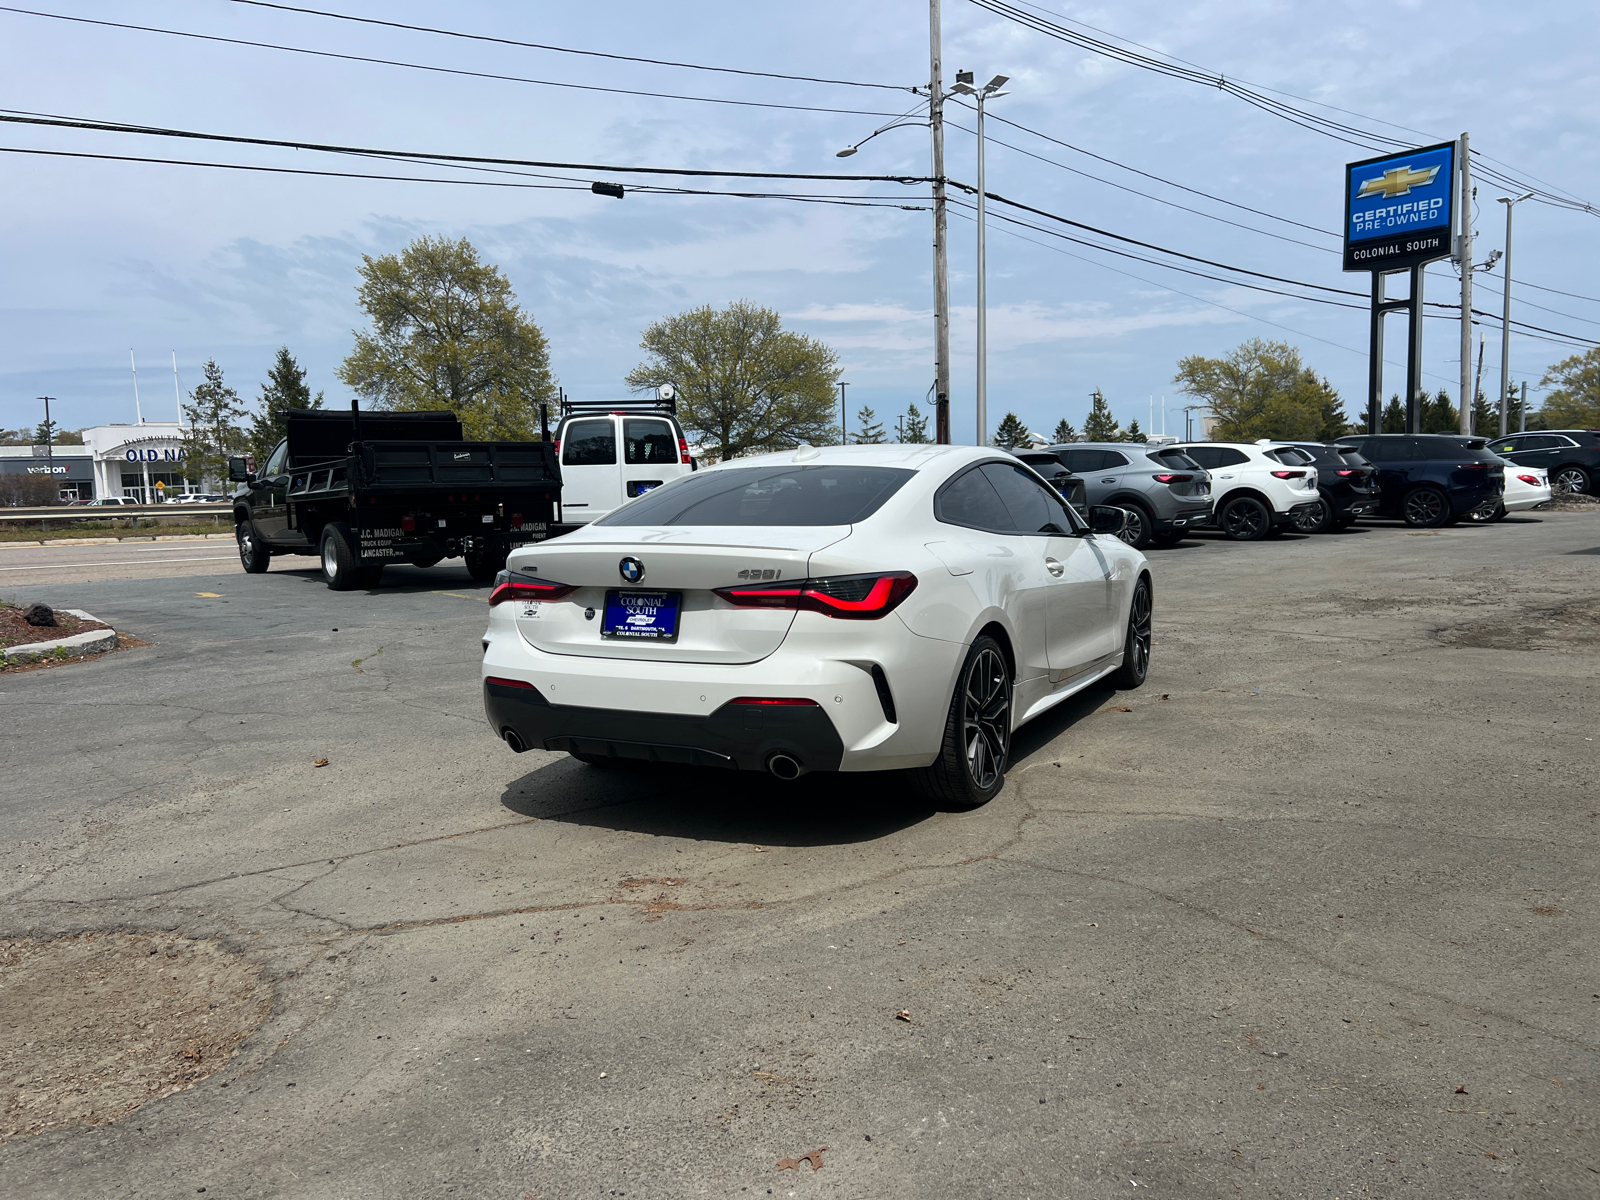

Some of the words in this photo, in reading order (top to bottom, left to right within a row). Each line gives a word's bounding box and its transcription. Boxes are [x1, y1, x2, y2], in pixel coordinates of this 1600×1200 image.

[1352, 197, 1443, 223] CERTIFIED
[1356, 209, 1438, 233] PRE-OWNED
[1353, 245, 1401, 260] COLONIAL
[1406, 238, 1439, 252] SOUTH
[124, 434, 178, 446] DARTMOUTH
[126, 449, 159, 462] OLD
[164, 449, 186, 462] NA
[27, 465, 67, 474] verizon
[360, 529, 373, 538] J.C.
[374, 528, 405, 538] MADIGAN
[361, 548, 396, 558] LANCASTER,
[621, 597, 664, 607] COLONIAL
[626, 606, 657, 615] SOUTH
